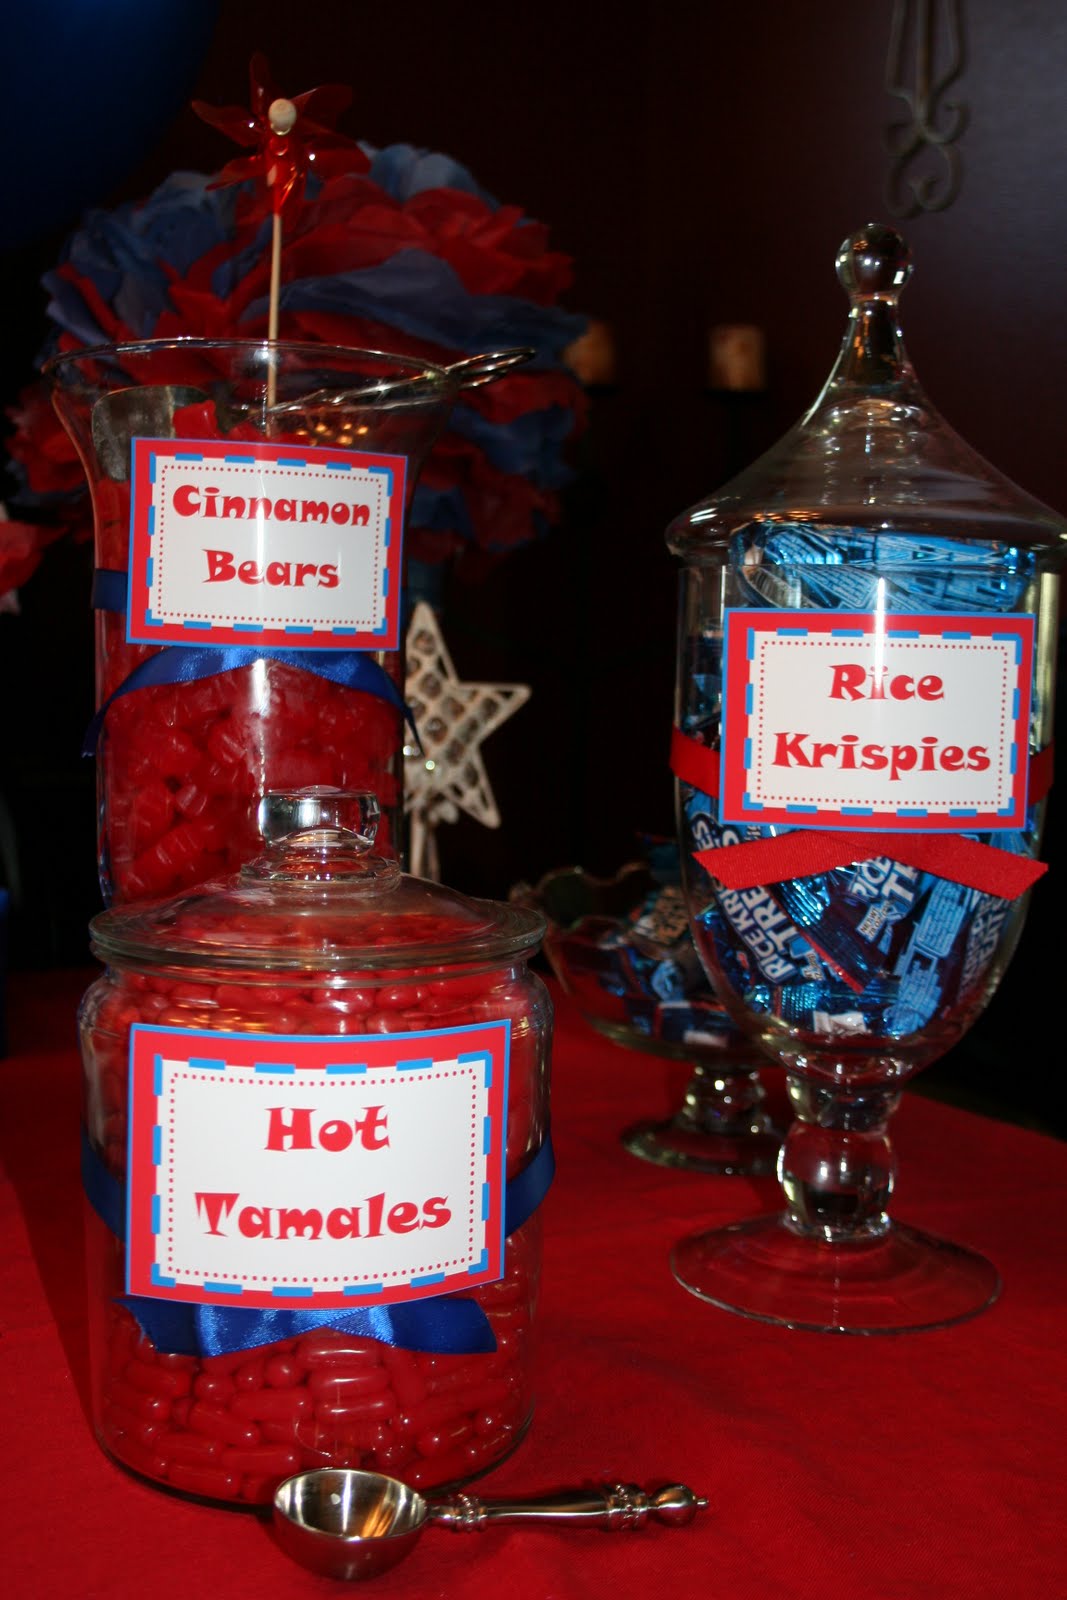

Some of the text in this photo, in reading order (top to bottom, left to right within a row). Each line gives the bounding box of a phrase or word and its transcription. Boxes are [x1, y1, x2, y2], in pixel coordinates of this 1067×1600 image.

[172, 484, 370, 527] Cinnamon
[205, 549, 340, 589] Bears
[829, 664, 944, 701] Rice
[773, 732, 990, 781] Krispies
[745, 929, 795, 979] RICE
[265, 1105, 390, 1152] Hot
[194, 1192, 452, 1241] Tamales
